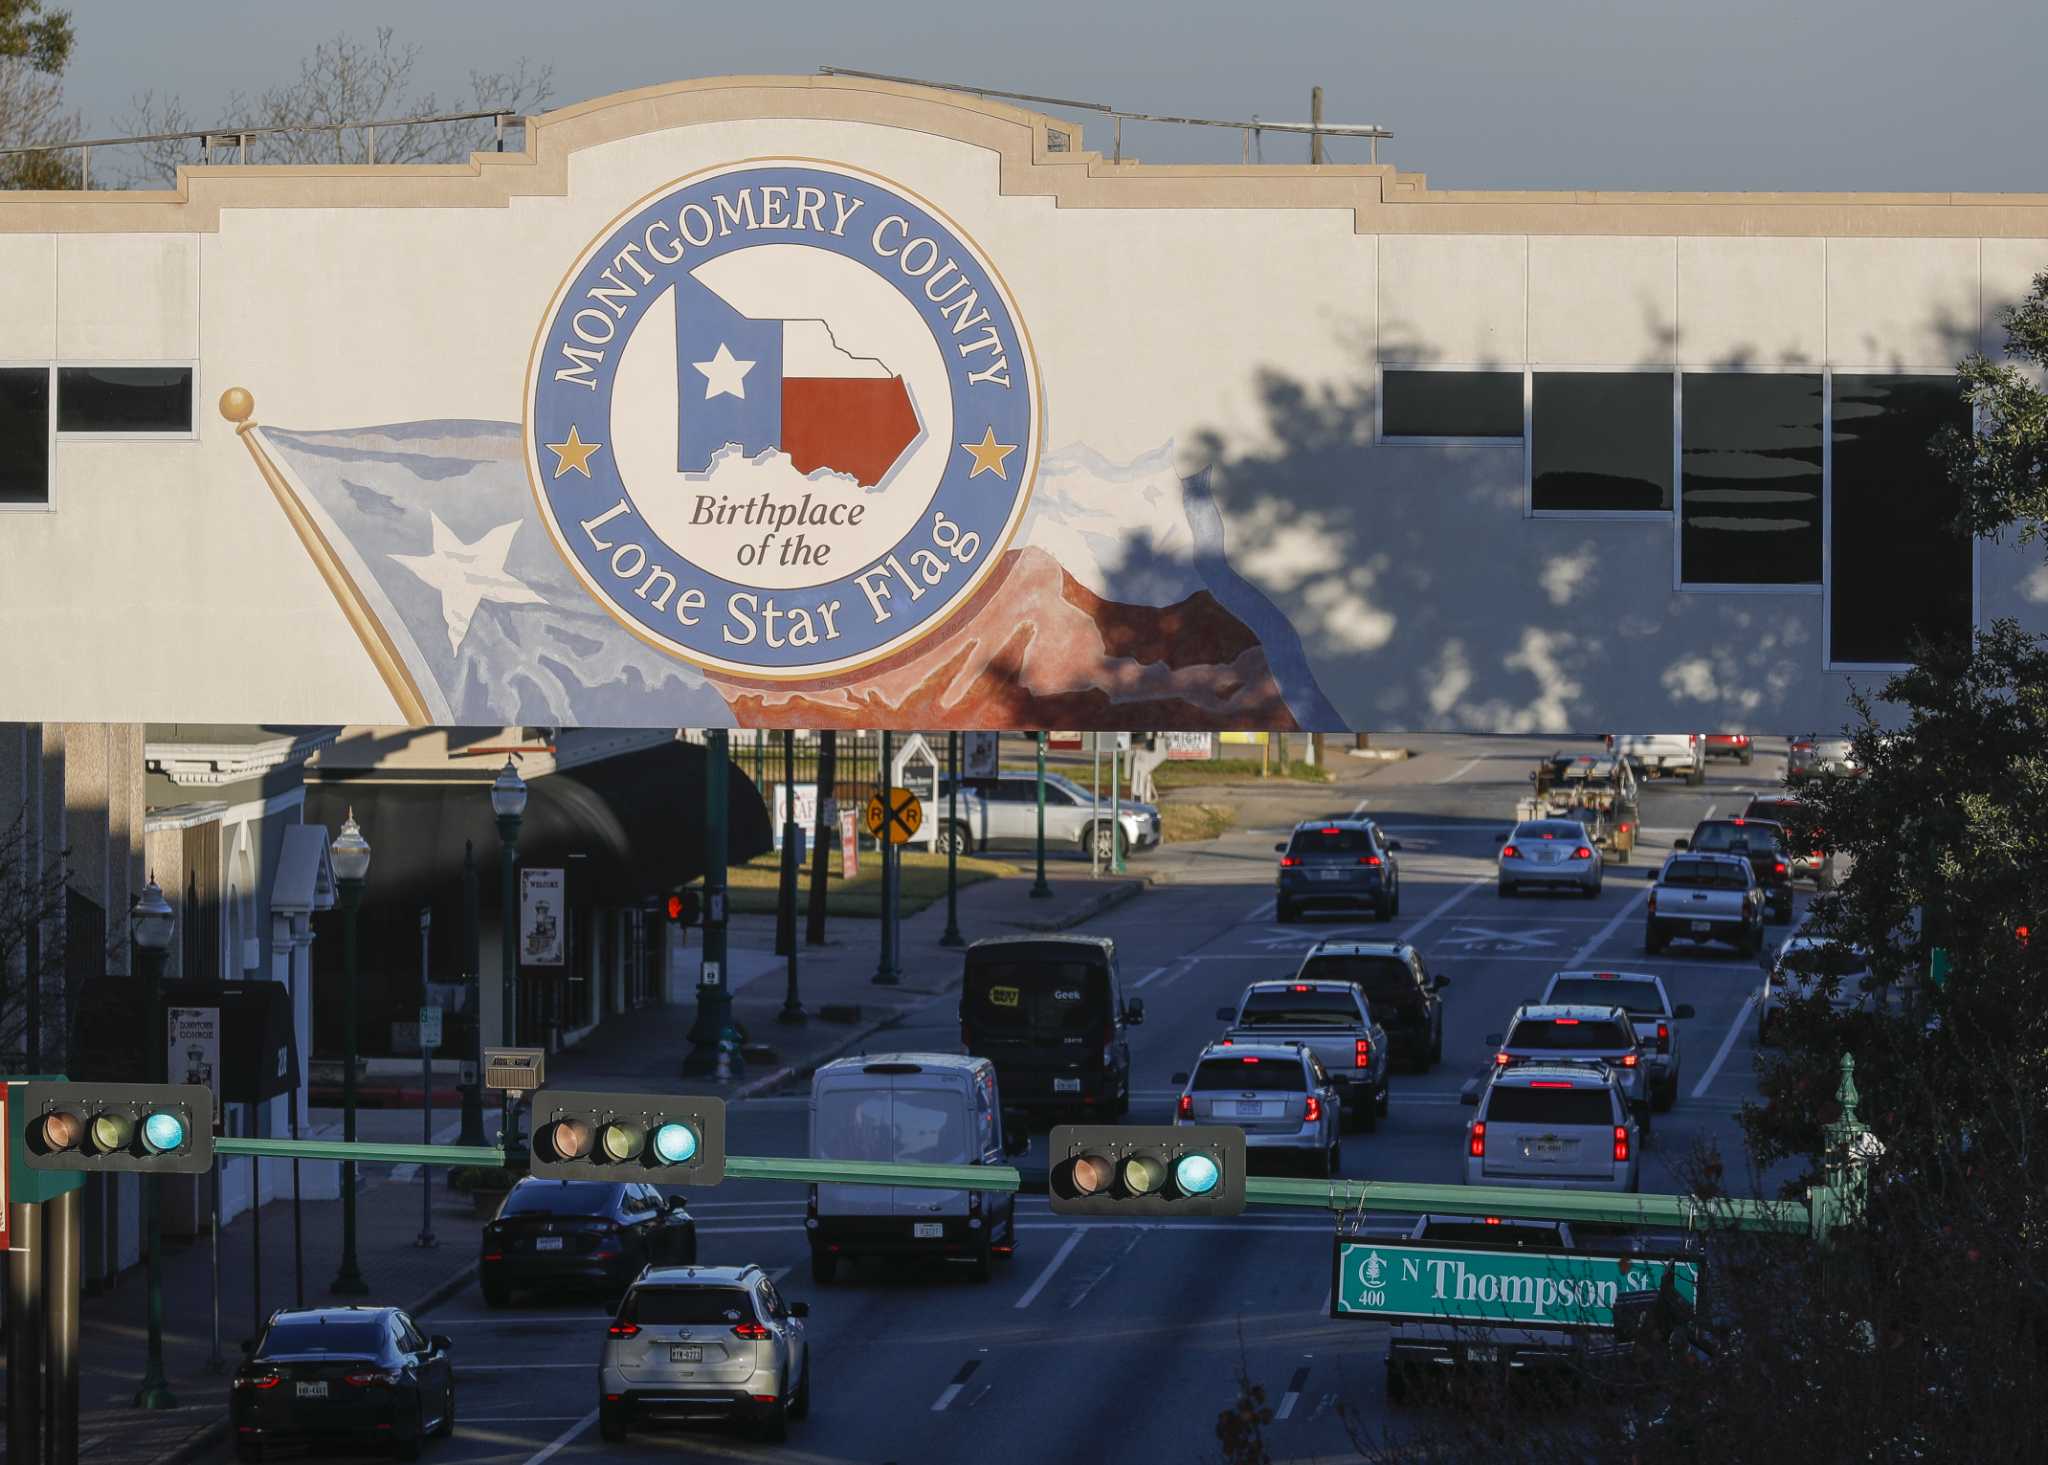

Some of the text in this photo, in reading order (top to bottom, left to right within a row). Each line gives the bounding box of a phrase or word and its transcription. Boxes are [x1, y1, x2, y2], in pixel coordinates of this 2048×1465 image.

[554, 186, 1012, 392] MONTGOMERY COUNTY
[688, 493, 865, 533] Birthplace
[737, 533, 831, 571] of the
[579, 498, 981, 649] Lone Star Flag
[871, 807, 917, 823] R R
[1054, 990, 1081, 1000] Geek
[180, 1022, 214, 1031] DOWNTOWN
[180, 1031, 215, 1040] CONROE
[1358, 1289, 1386, 1307] 400
[1401, 1257, 1421, 1282] N
[1426, 1259, 1618, 1316] Thompson
